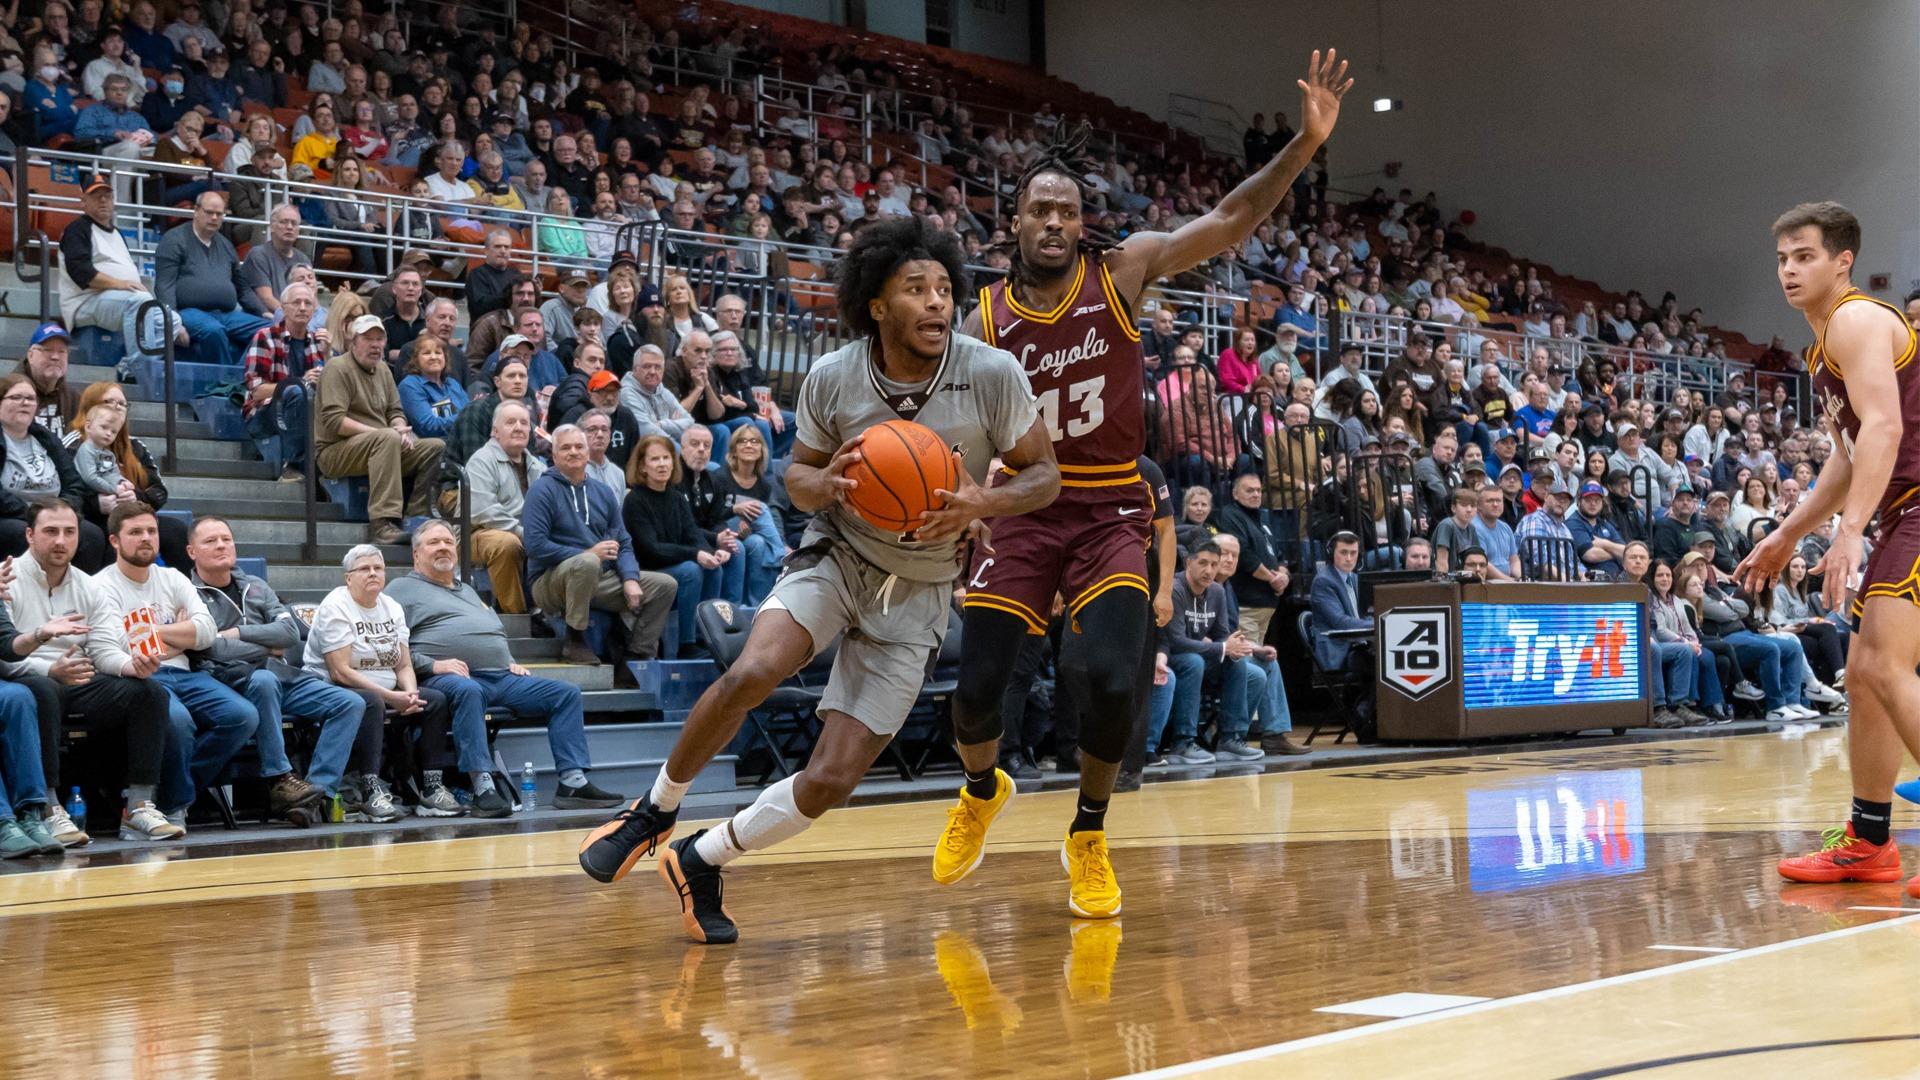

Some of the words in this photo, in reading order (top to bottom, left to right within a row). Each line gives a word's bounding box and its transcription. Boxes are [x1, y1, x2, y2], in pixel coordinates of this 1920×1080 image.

[1020, 326, 1109, 377] Loyola
[897, 404, 918, 412] adidas
[1035, 374, 1105, 442] 13
[970, 558, 995, 588] L
[1396, 620, 1440, 647] A
[1390, 649, 1440, 671] 10
